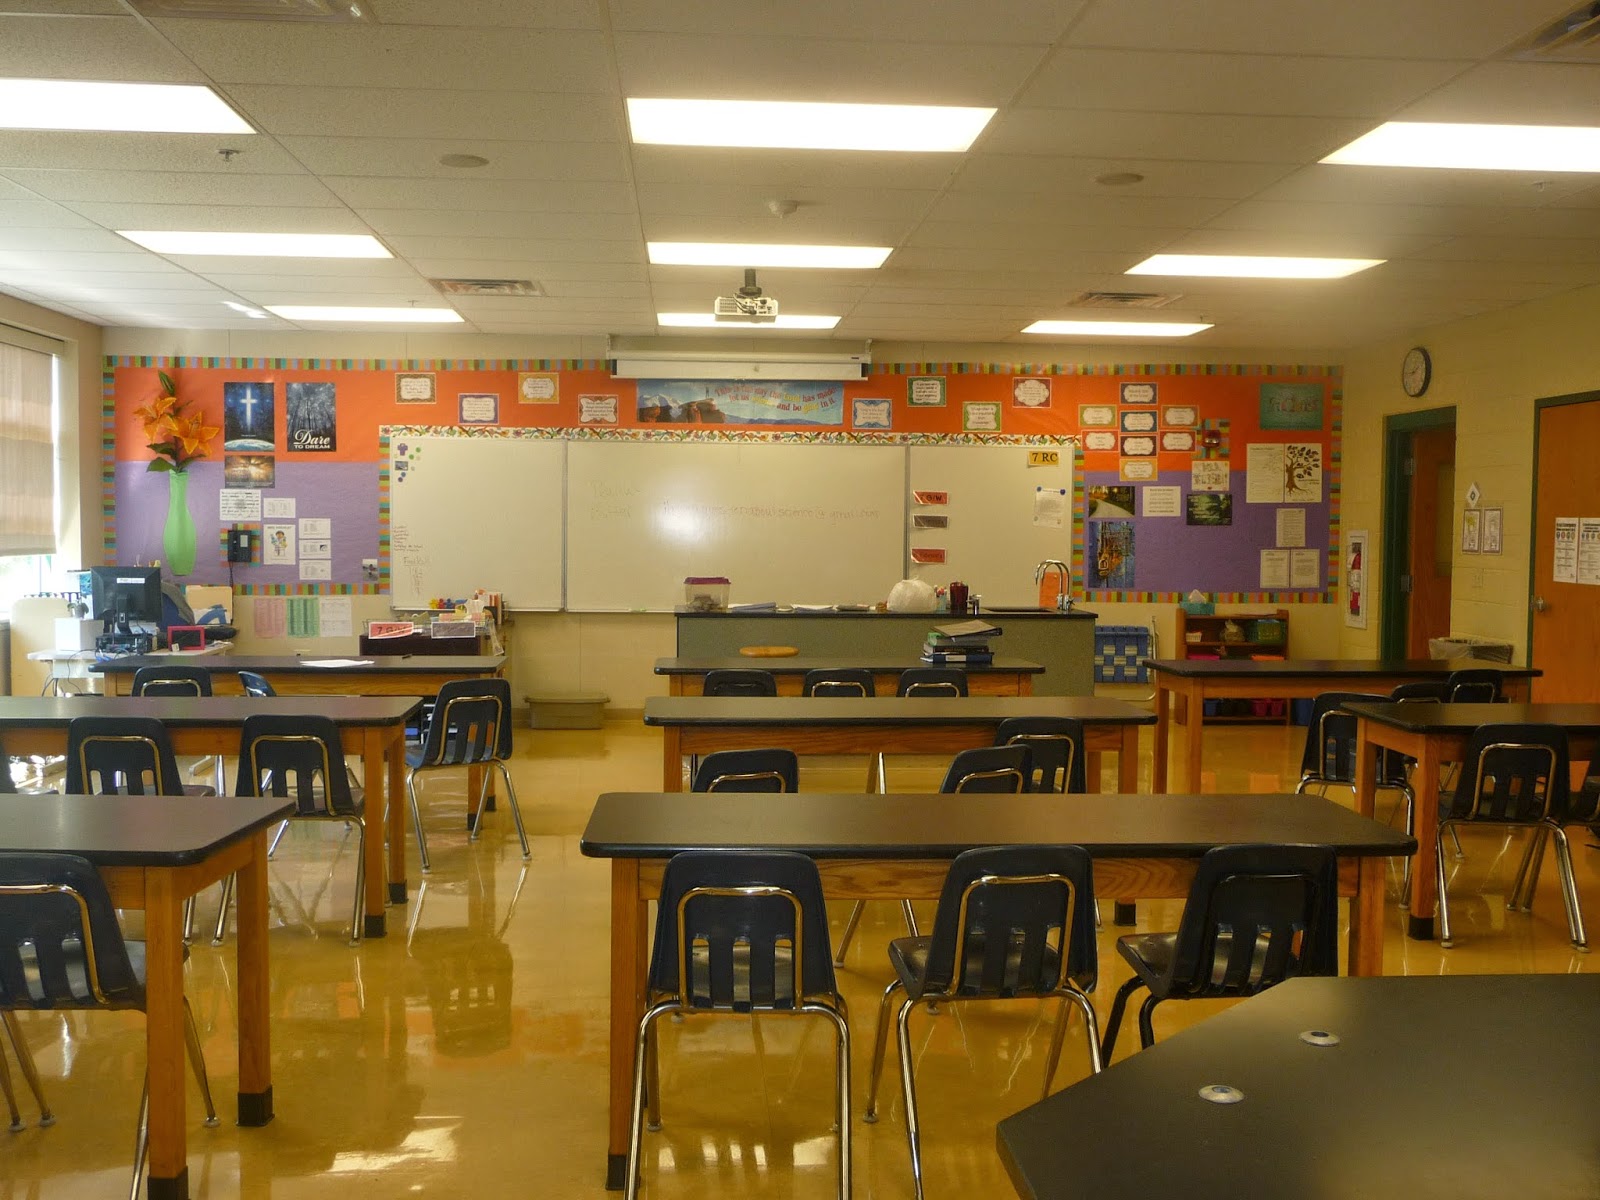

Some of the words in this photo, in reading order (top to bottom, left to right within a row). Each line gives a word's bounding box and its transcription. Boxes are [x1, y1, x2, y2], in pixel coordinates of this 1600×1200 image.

[740, 393, 750, 401] us
[776, 403, 791, 411] and
[792, 403, 802, 411] be
[802, 394, 816, 402] has
[293, 429, 331, 445] Dare
[1031, 452, 1039, 462] 7
[1042, 452, 1058, 462] RC
[377, 626, 383, 635] 7
